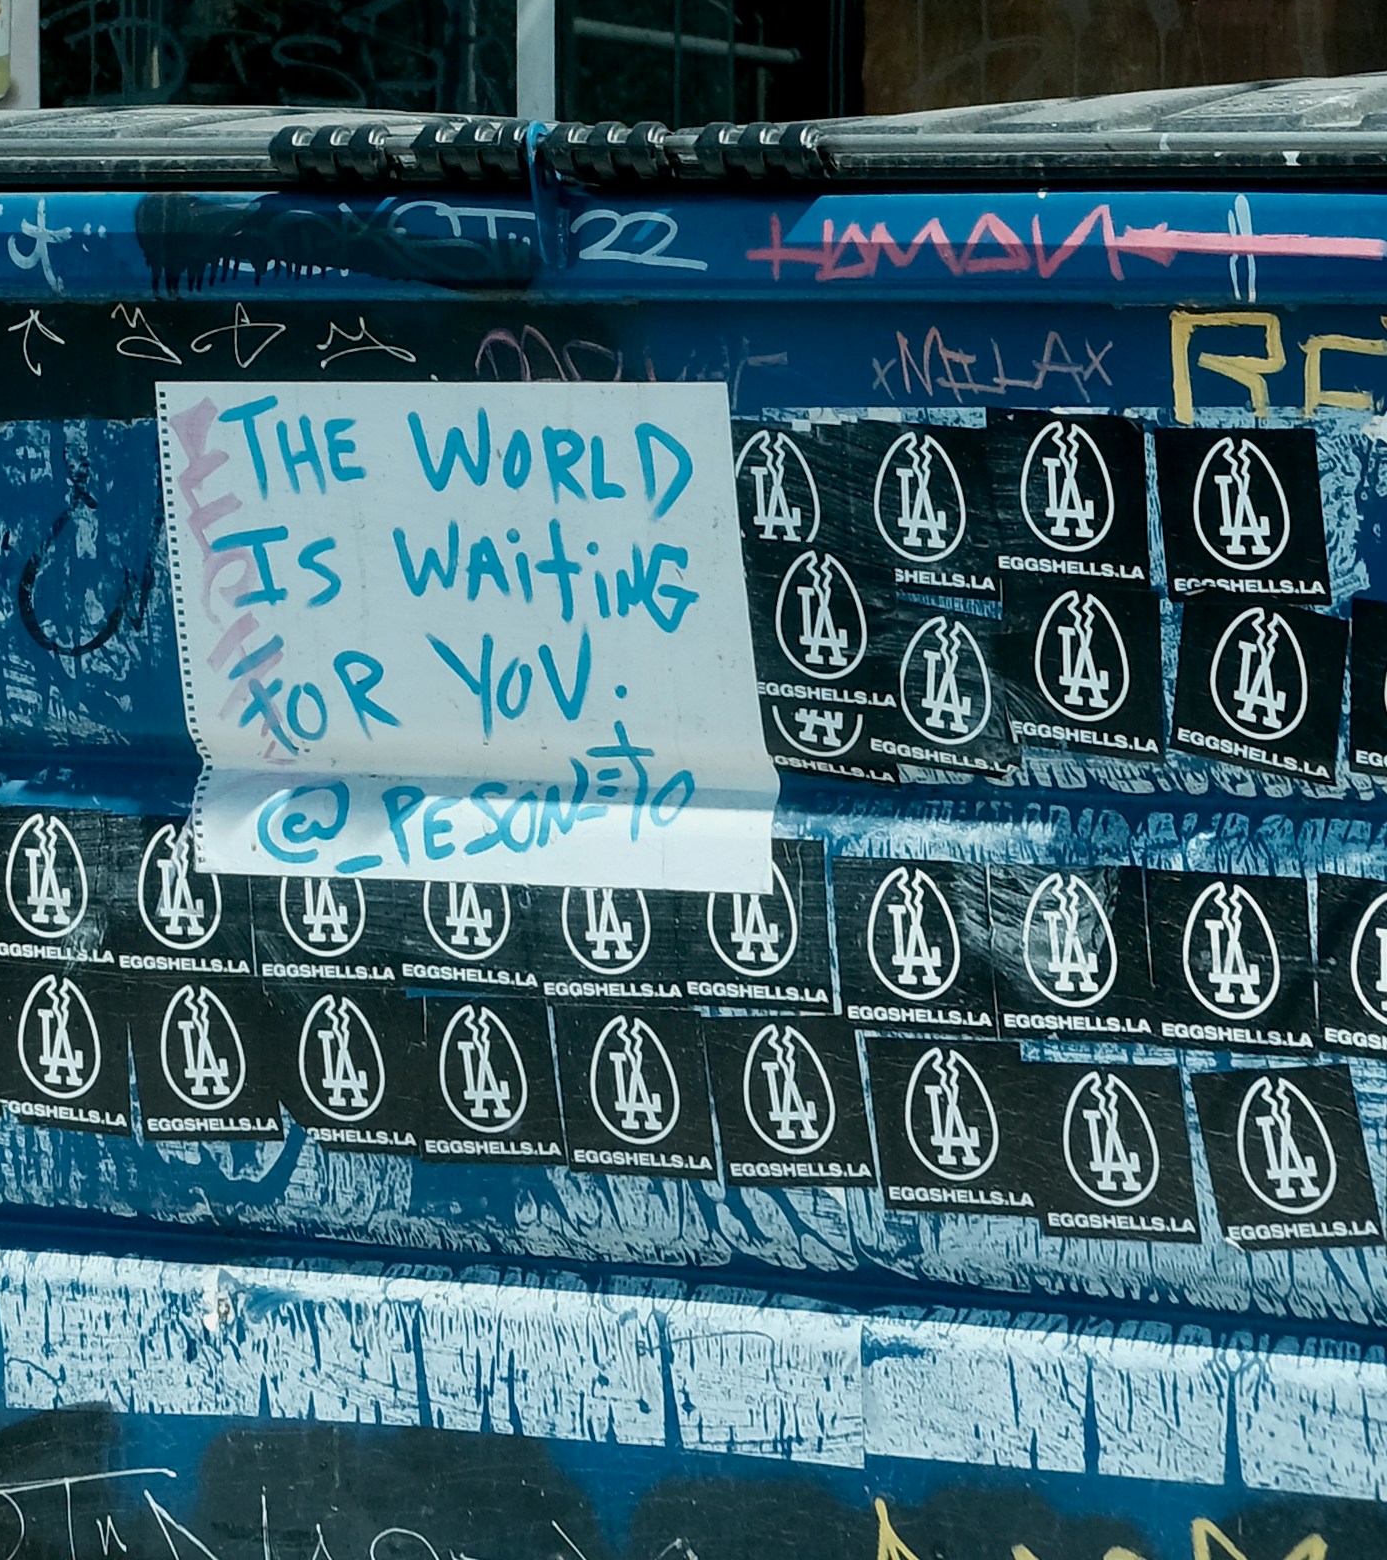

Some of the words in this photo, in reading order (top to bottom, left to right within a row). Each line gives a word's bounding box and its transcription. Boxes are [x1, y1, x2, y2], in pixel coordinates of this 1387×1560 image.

[219, 395, 366, 499] THE
[210, 525, 343, 607] IS
[999, 555, 1144, 580] EGGSHELLS.LA
[229, 634, 402, 753] FOR
[1014, 721, 1158, 754] EGGSHELLS.LA
[1177, 727, 1330, 779] EGGSHELLS.LA
[120, 955, 249, 974] EGGSHELLS.LA
[263, 963, 395, 981] EGGSHELLS.LA
[403, 964, 538, 988] EGGSHELLS.LA
[544, 982, 682, 1000] EGGSHELLS.LA
[687, 981, 828, 1003] EGGSHELLS.LA
[848, 1005, 991, 1029] EGGSHELLS.LA
[1003, 1013, 1151, 1035] EGGSHELLS.LA
[1161, 1022, 1313, 1048] EGGSHELLS.LA
[147, 1116, 278, 1133] EGGSHELLS.LA
[425, 1138, 561, 1157] EGGSHELLS.LA
[574, 1150, 713, 1171] EGGSHELLS.LA
[730, 1162, 871, 1179] EGGSHELLS.LA
[889, 1186, 1034, 1207] EGGSHELLS.LA
[1048, 1212, 1195, 1235] EGGSHELLS.LA
[1228, 1221, 1378, 1241] EGGSHELLS.LA
